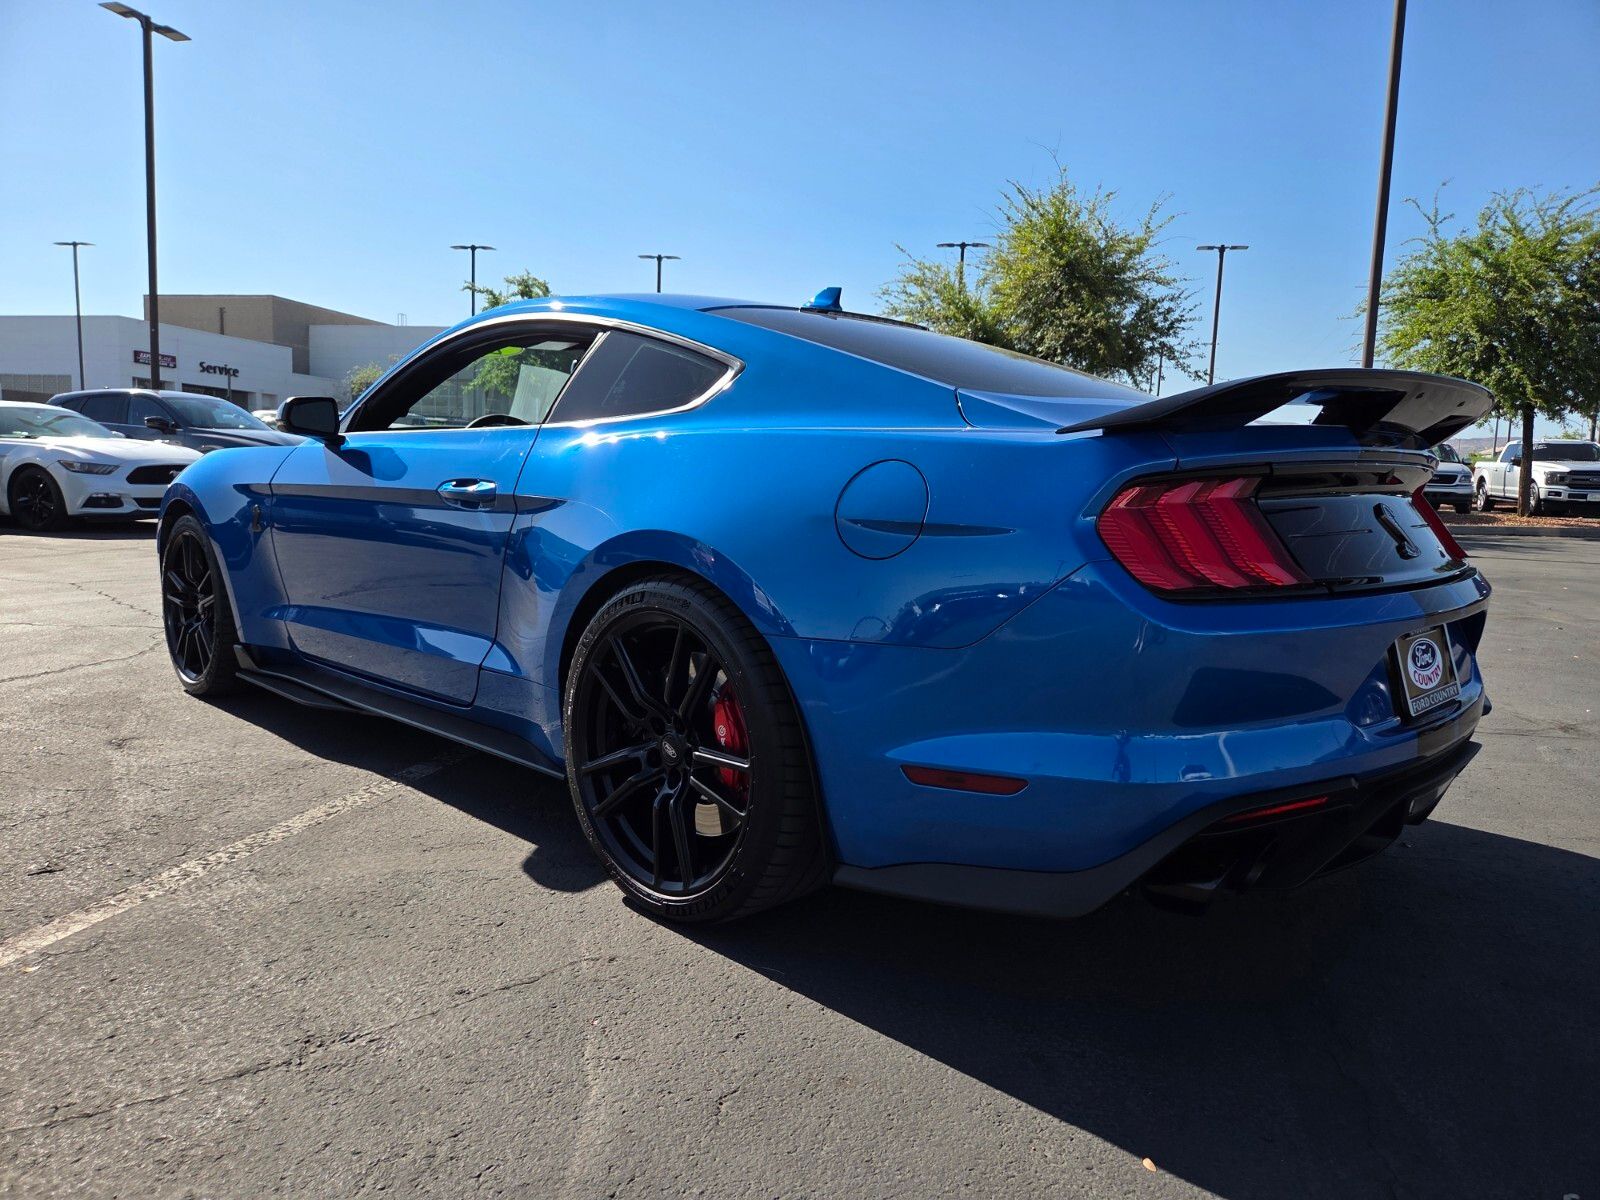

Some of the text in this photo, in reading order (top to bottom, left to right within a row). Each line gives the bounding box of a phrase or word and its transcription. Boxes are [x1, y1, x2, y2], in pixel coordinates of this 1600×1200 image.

[199, 361, 239, 377] Service
[1415, 645, 1433, 666] Ford
[1413, 665, 1442, 686] COUNTRY
[1412, 685, 1458, 712] FORD COUNTRY
